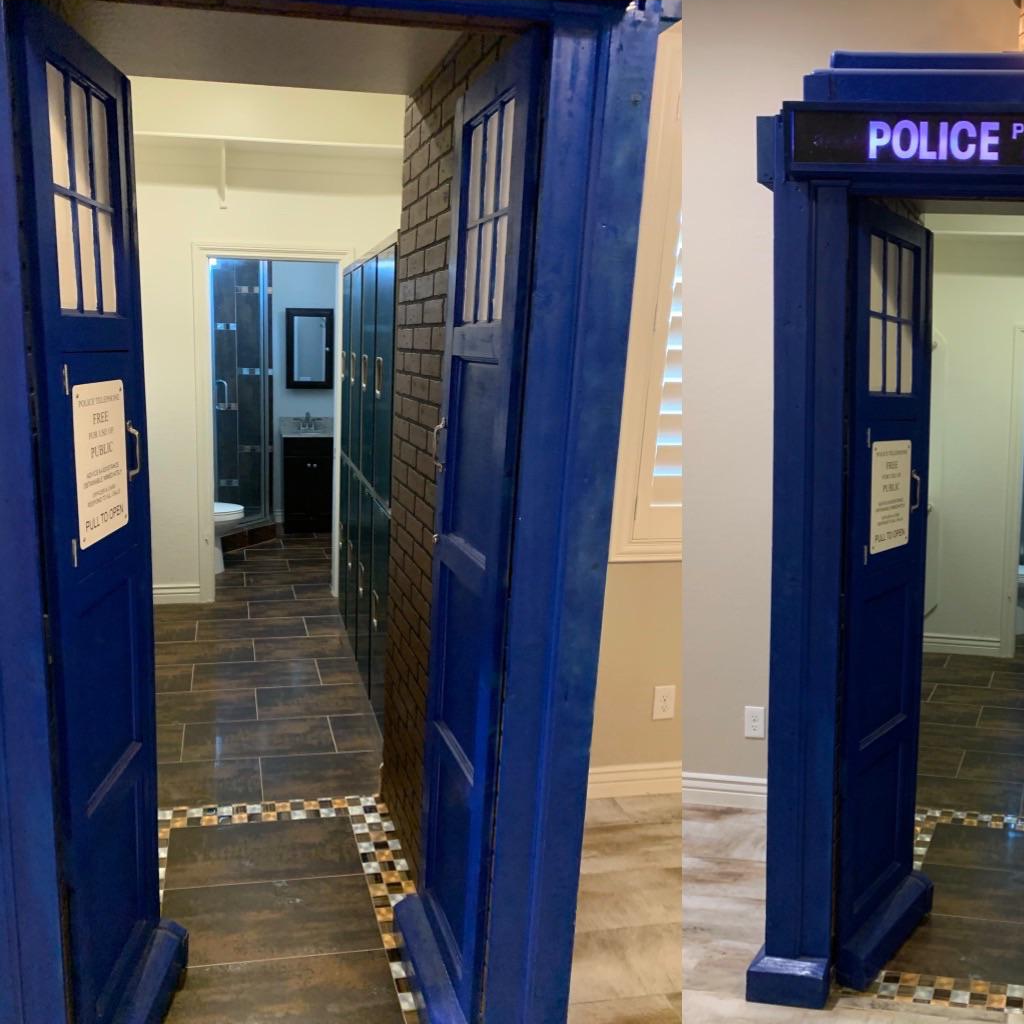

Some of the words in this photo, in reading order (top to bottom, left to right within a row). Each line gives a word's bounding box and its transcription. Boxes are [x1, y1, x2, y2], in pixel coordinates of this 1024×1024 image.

[869, 120, 999, 161] POLICE
[93, 411, 108, 424] FREE
[91, 442, 113, 458] PUBLIC
[86, 517, 100, 531] PULL
[101, 512, 108, 523] TO
[110, 504, 123, 519] OPEN
